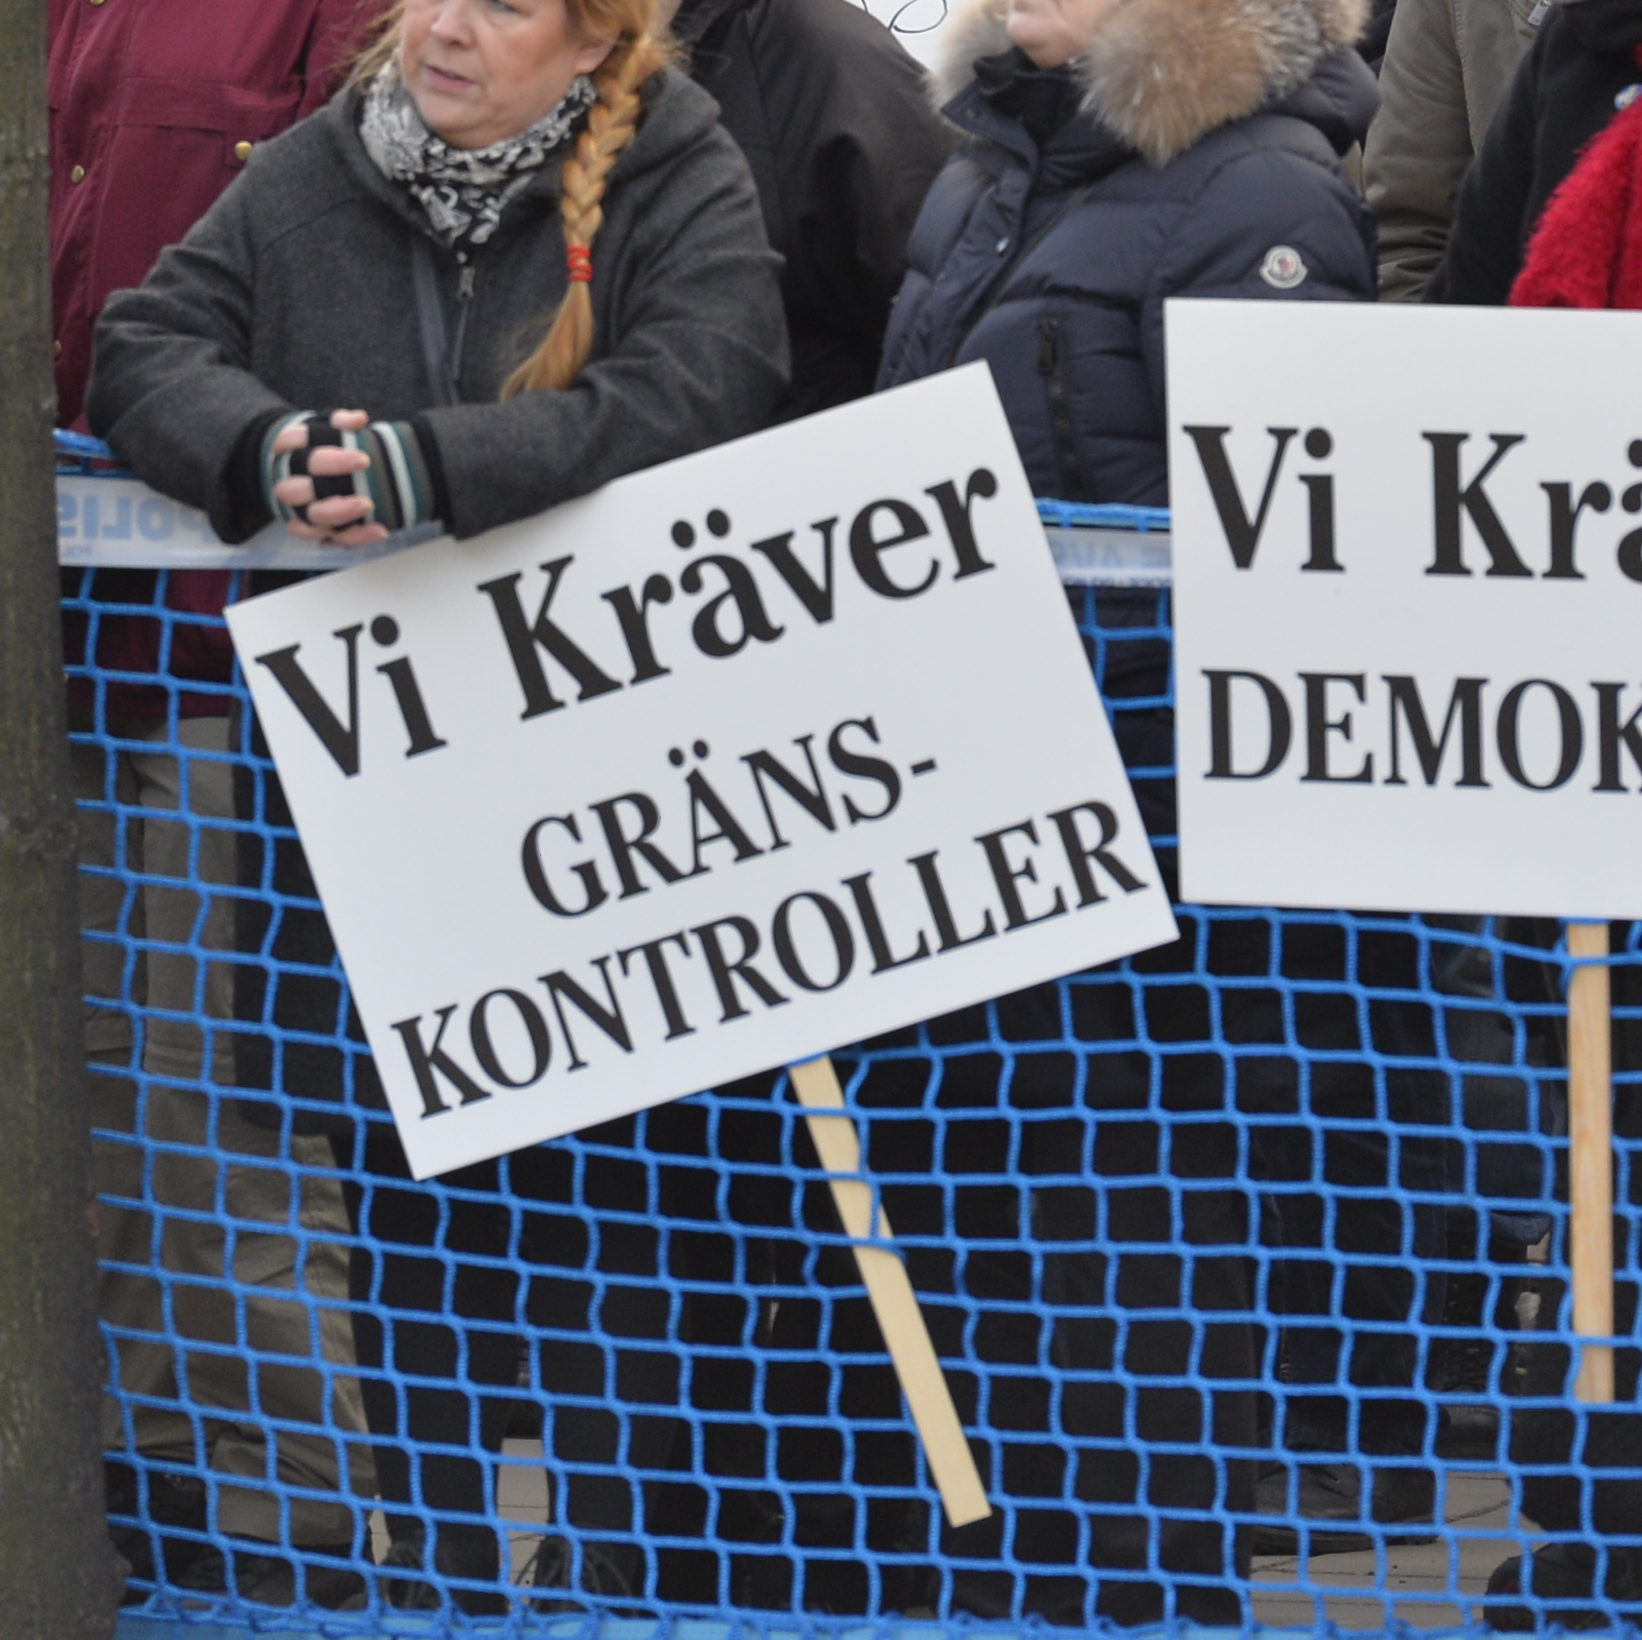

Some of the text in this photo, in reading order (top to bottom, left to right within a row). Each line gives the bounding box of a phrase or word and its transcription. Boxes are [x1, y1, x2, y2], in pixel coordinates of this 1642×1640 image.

[257, 469, 998, 777] Vi Kräver
[1183, 426, 1344, 572] Vi
[522, 717, 937, 917] GRÄNS-
[391, 800, 1146, 1119] KONTROLLER
